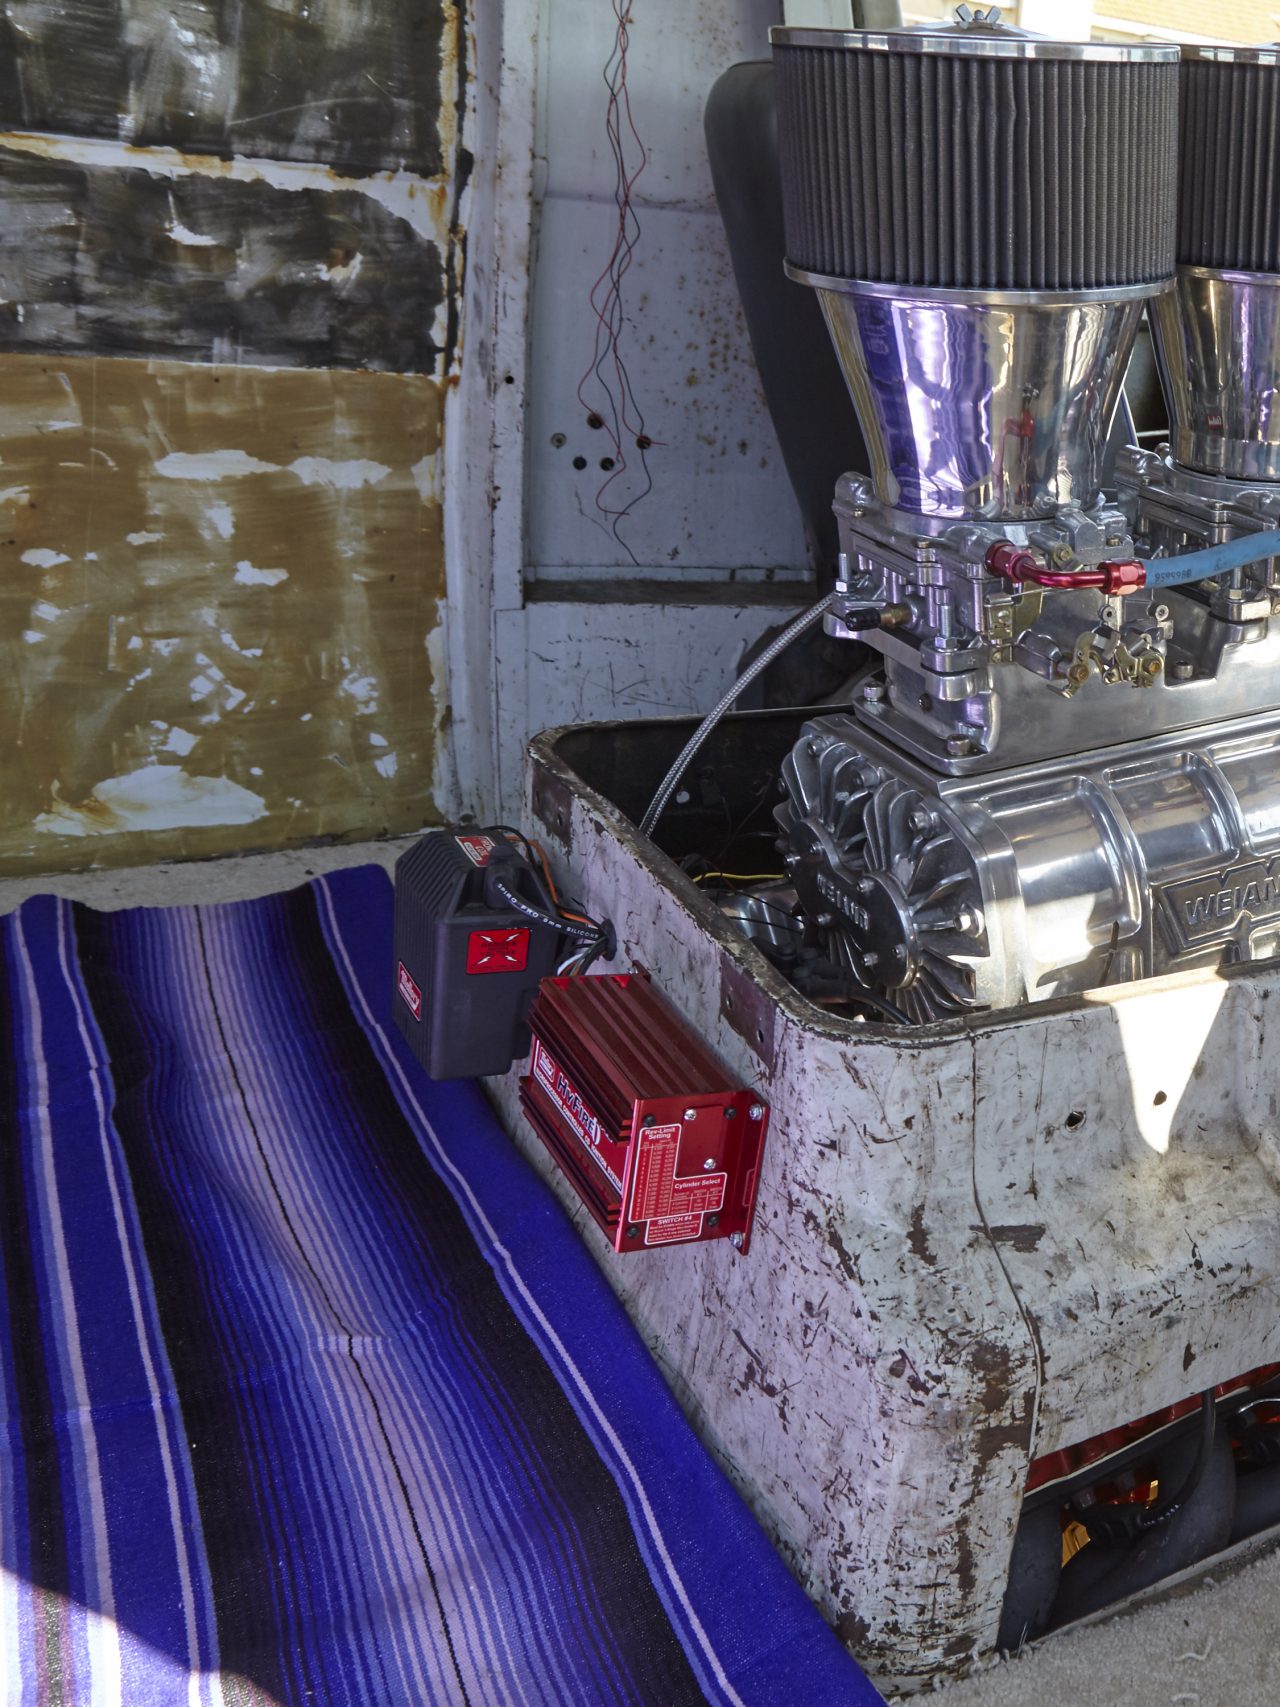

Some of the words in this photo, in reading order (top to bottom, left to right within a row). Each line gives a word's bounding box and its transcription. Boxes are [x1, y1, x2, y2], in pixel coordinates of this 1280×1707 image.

[497, 883, 517, 903] SPIRO
[520, 904, 539, 918] PRO
[566, 926, 599, 938] SILICONE
[645, 1127, 676, 1135] Rev-Limit
[674, 1181, 700, 1189] Cylinder
[701, 1178, 721, 1186] Select
[657, 1216, 683, 1225] SWITCH
